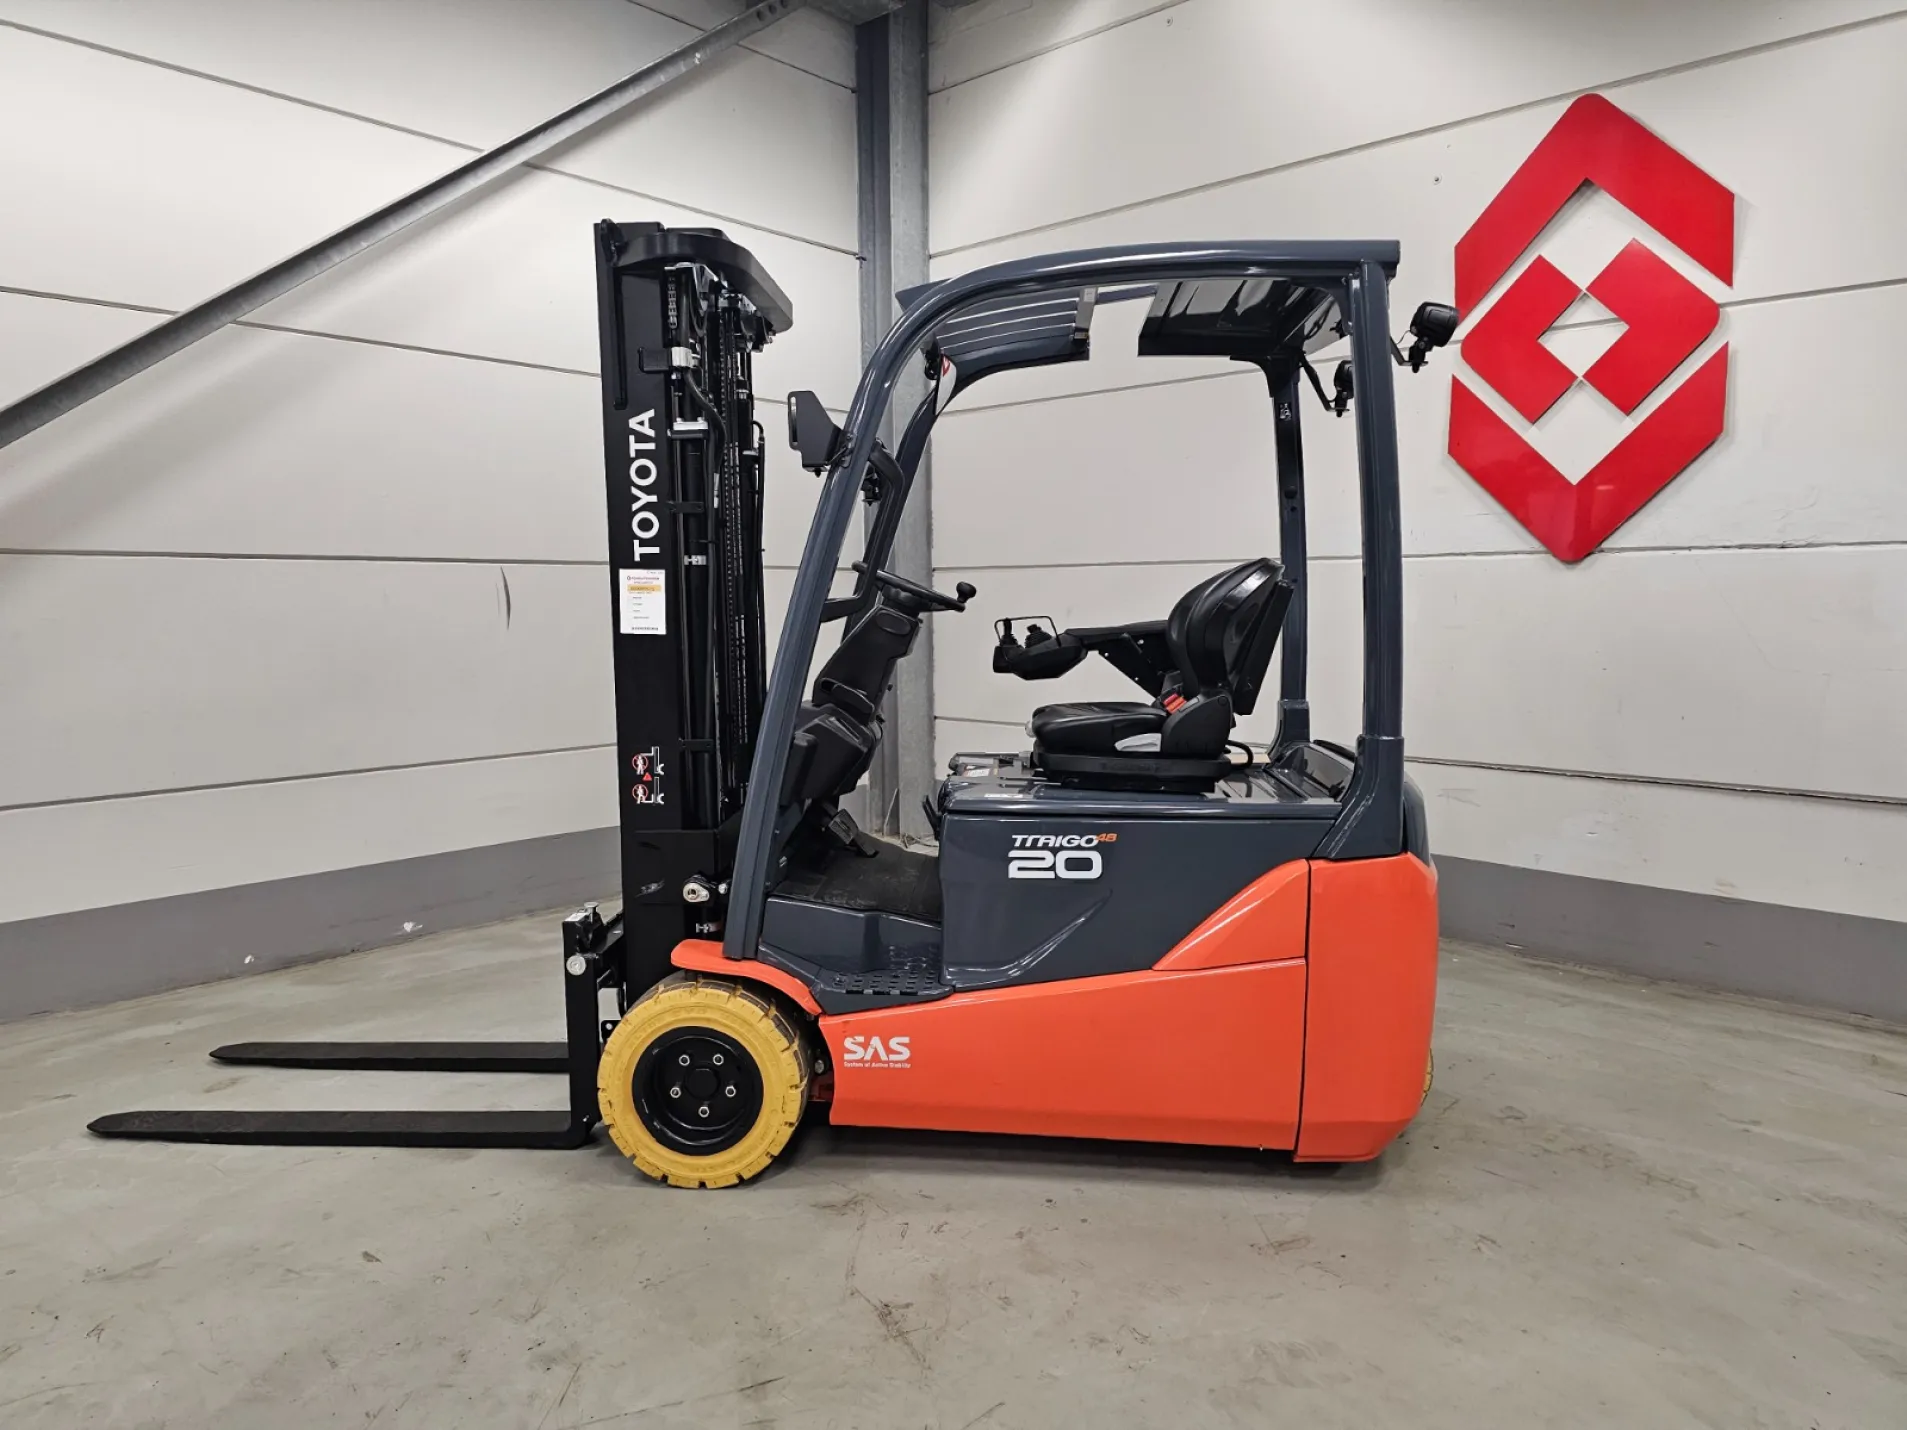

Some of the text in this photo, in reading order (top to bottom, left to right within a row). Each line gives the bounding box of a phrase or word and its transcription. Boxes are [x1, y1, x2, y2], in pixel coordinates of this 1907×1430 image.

[628, 408, 660, 562] TOYOTA
[1008, 850, 1102, 879] 20
[843, 1036, 910, 1061] SAS
